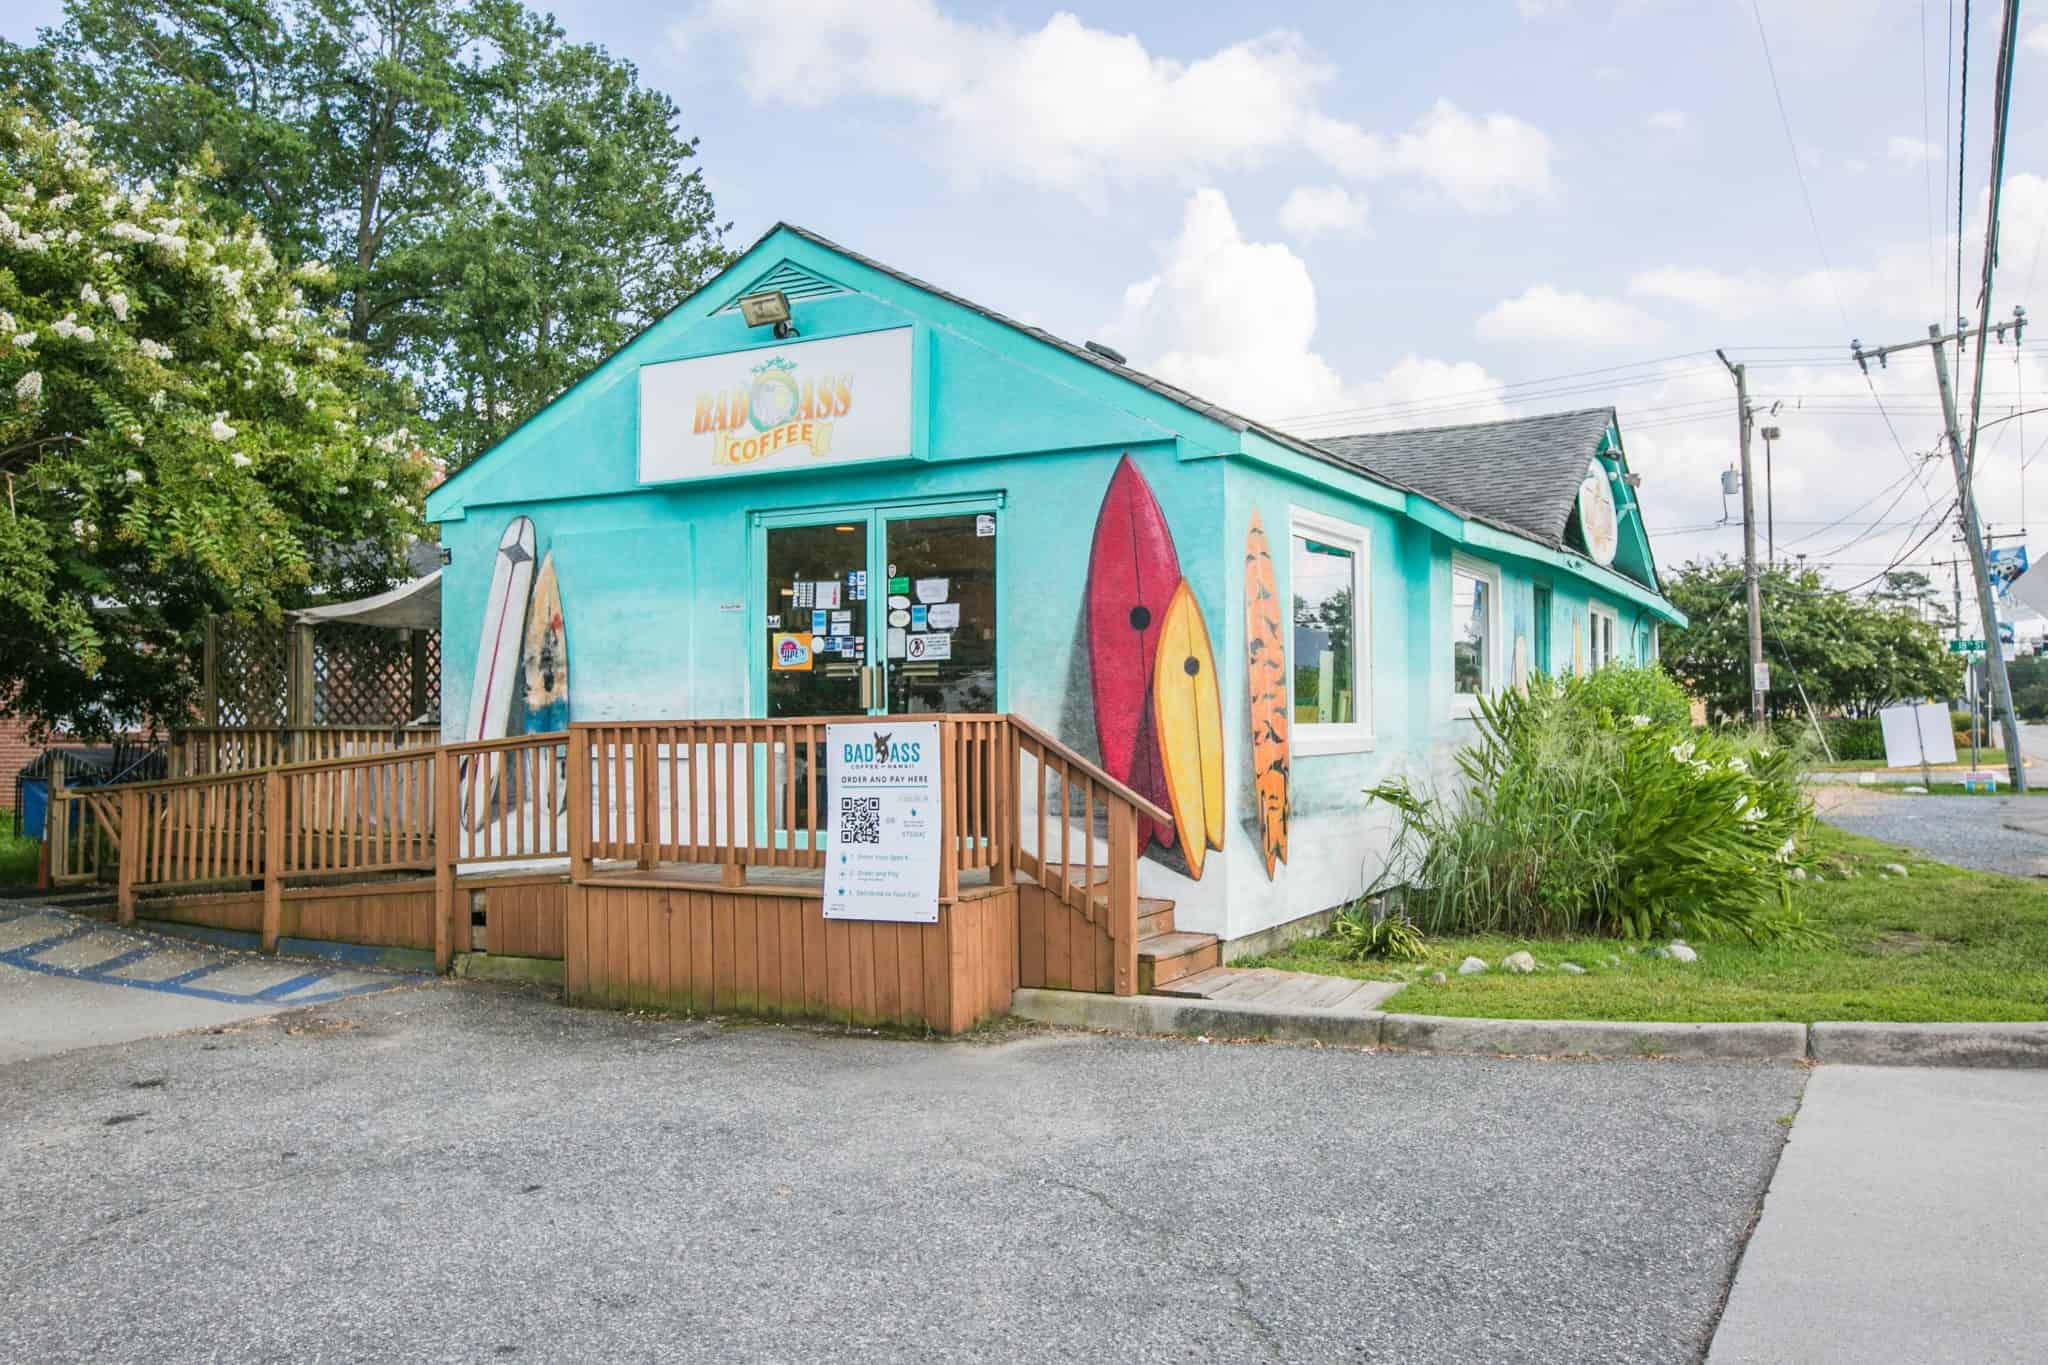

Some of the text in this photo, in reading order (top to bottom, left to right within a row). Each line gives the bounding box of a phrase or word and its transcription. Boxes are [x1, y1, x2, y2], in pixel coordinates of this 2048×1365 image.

[692, 374, 852, 435] BAD ASS
[728, 423, 813, 463] COFFEE
[844, 743, 920, 763] BAD ASS
[841, 775, 928, 783] ORDER AND PAY HERE
